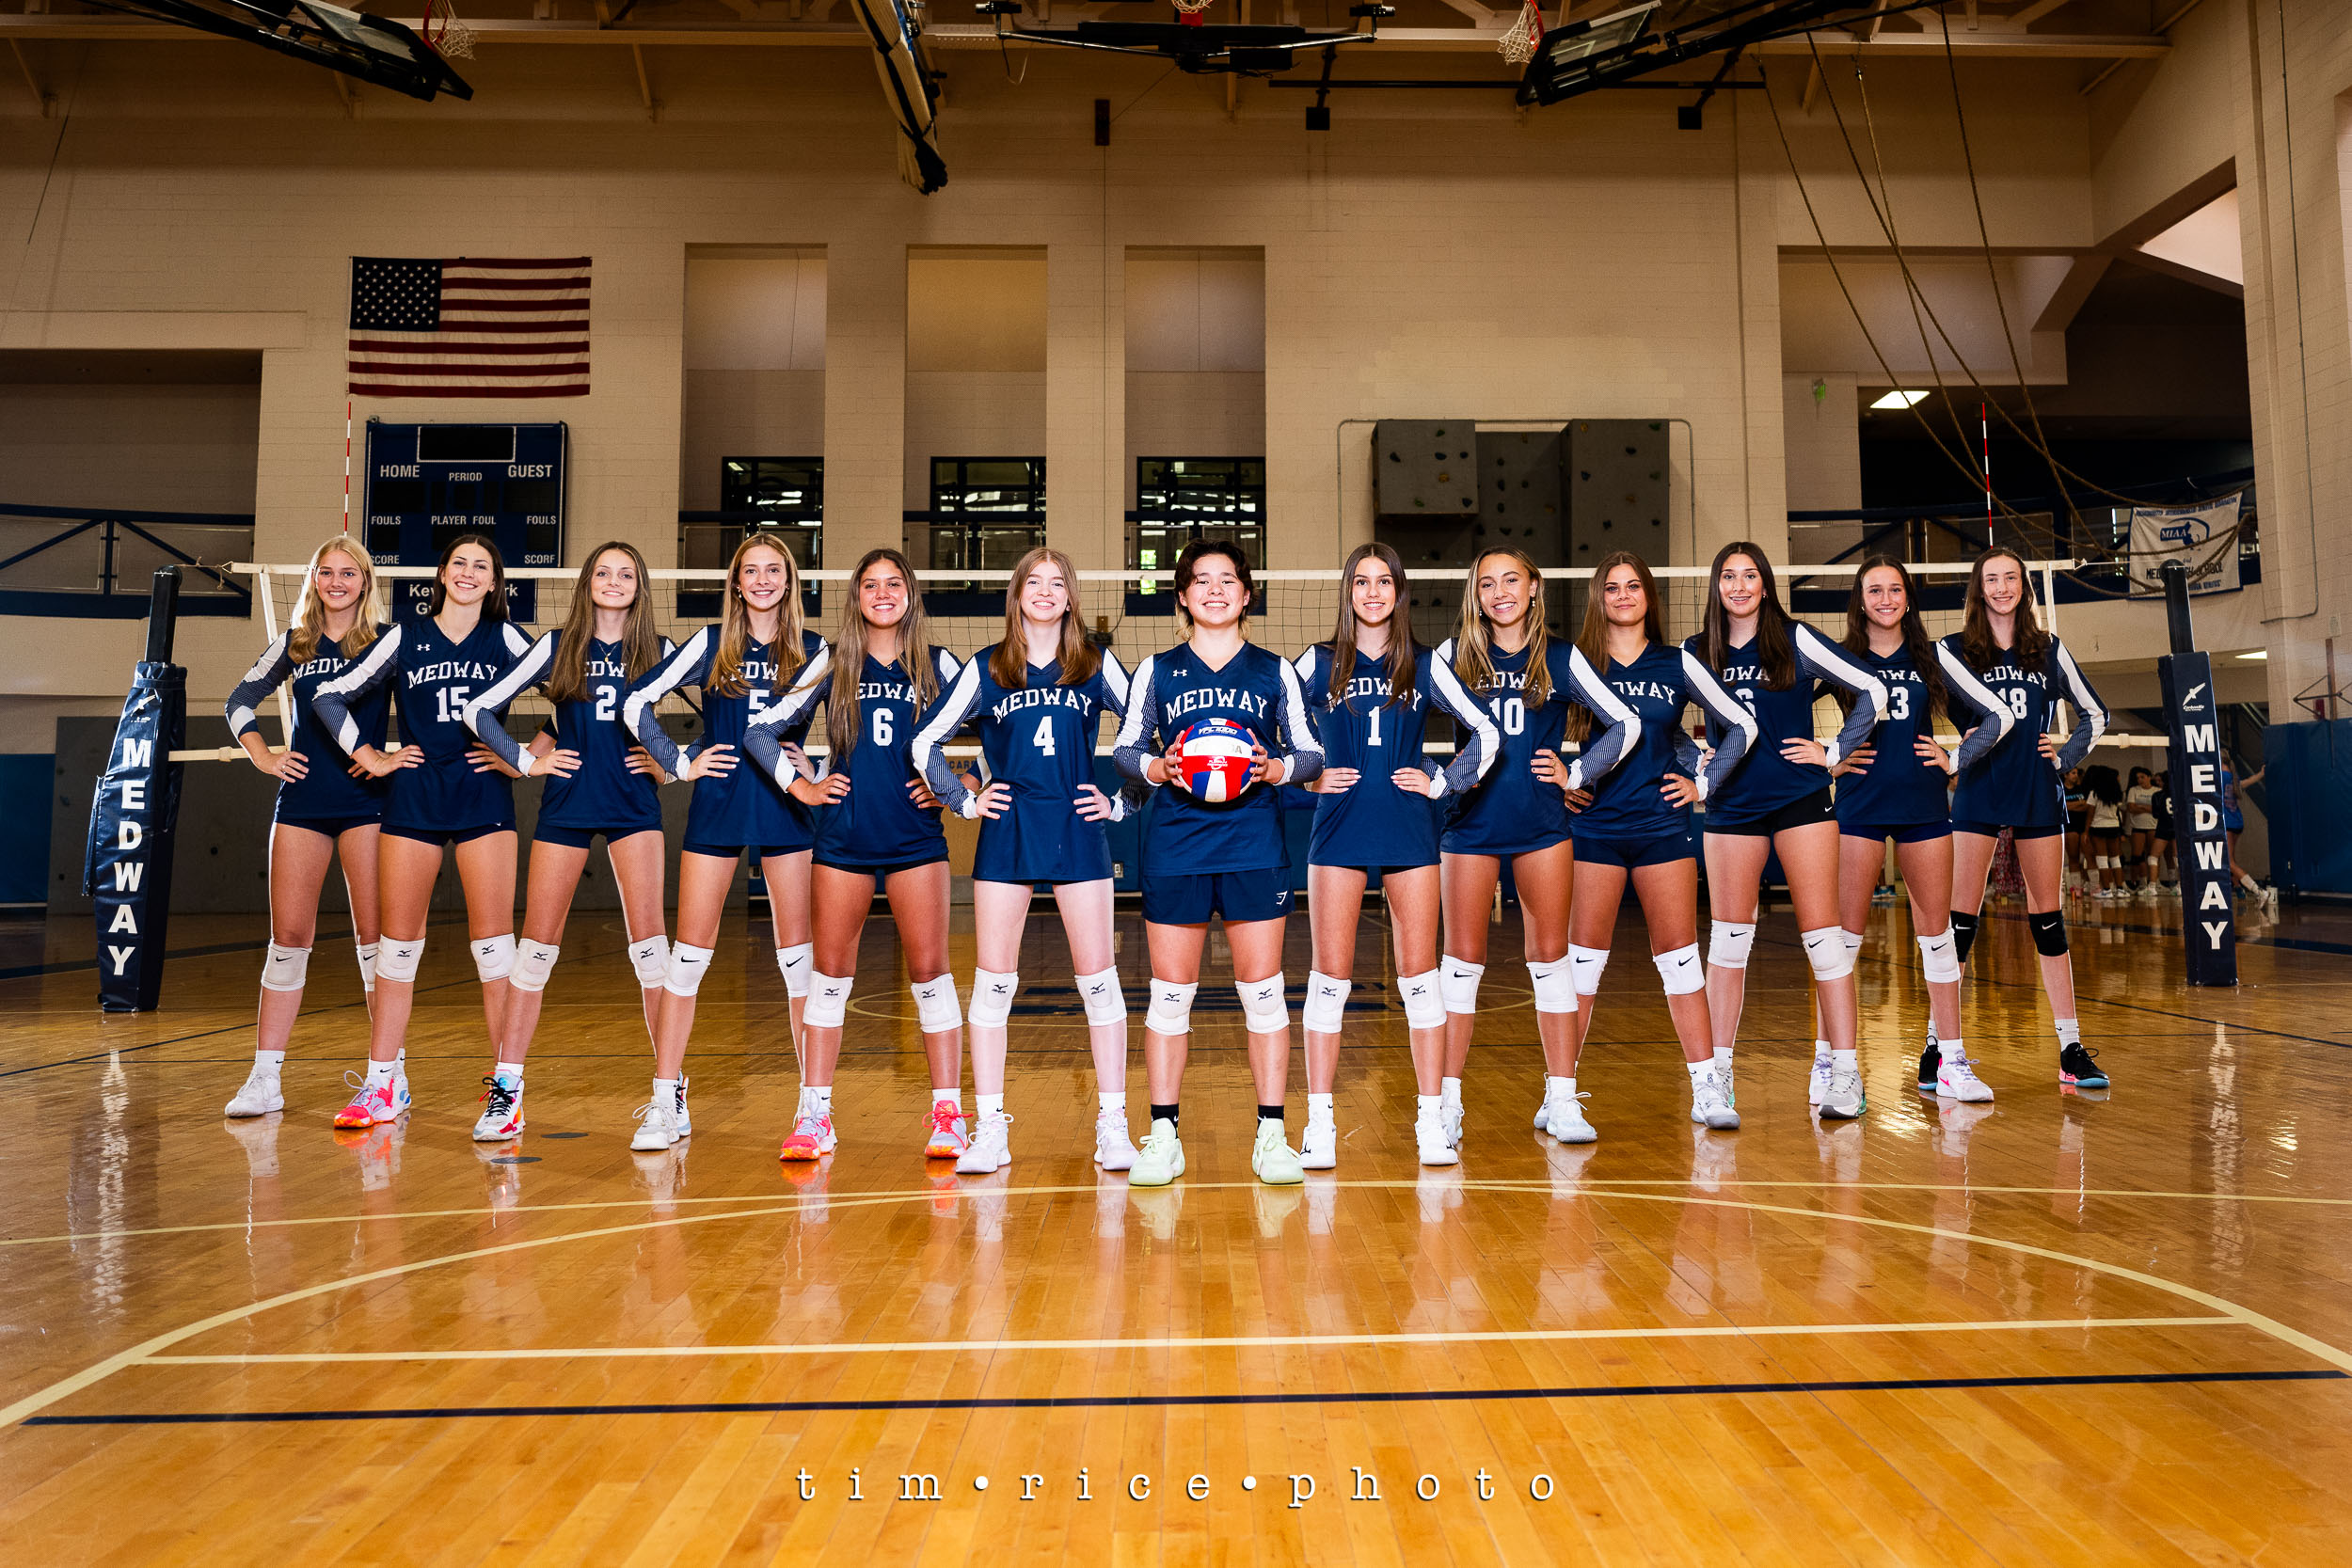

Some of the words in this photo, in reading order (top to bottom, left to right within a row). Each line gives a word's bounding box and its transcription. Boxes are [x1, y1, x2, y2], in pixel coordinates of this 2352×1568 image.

[380, 465, 421, 478] HOME
[448, 472, 483, 482] PERIOD
[507, 465, 553, 478] GUEST
[371, 515, 402, 525] FOULS
[431, 515, 467, 525] PLAYER
[472, 515, 497, 525] FOUL
[526, 515, 557, 525] FOULS
[2161, 527, 2187, 540] MIAA
[293, 657, 351, 684] MEDW
[406, 660, 498, 689] MEDWAY
[1983, 666, 2047, 690] EDWAY
[436, 686, 470, 722] 15
[596, 685, 617, 721] 2
[748, 689, 770, 724] 5
[993, 688, 1092, 724] MEDWAY
[1166, 687, 1268, 725] MEDWAY
[1327, 676, 1422, 713] EDWY
[872, 707, 894, 747] 6
[1367, 705, 1382, 746] 1
[1489, 697, 1525, 736] 10
[1033, 716, 1056, 756] 4
[2184, 723, 2229, 950] MEDWAY
[108, 737, 152, 976] MEDWAY
